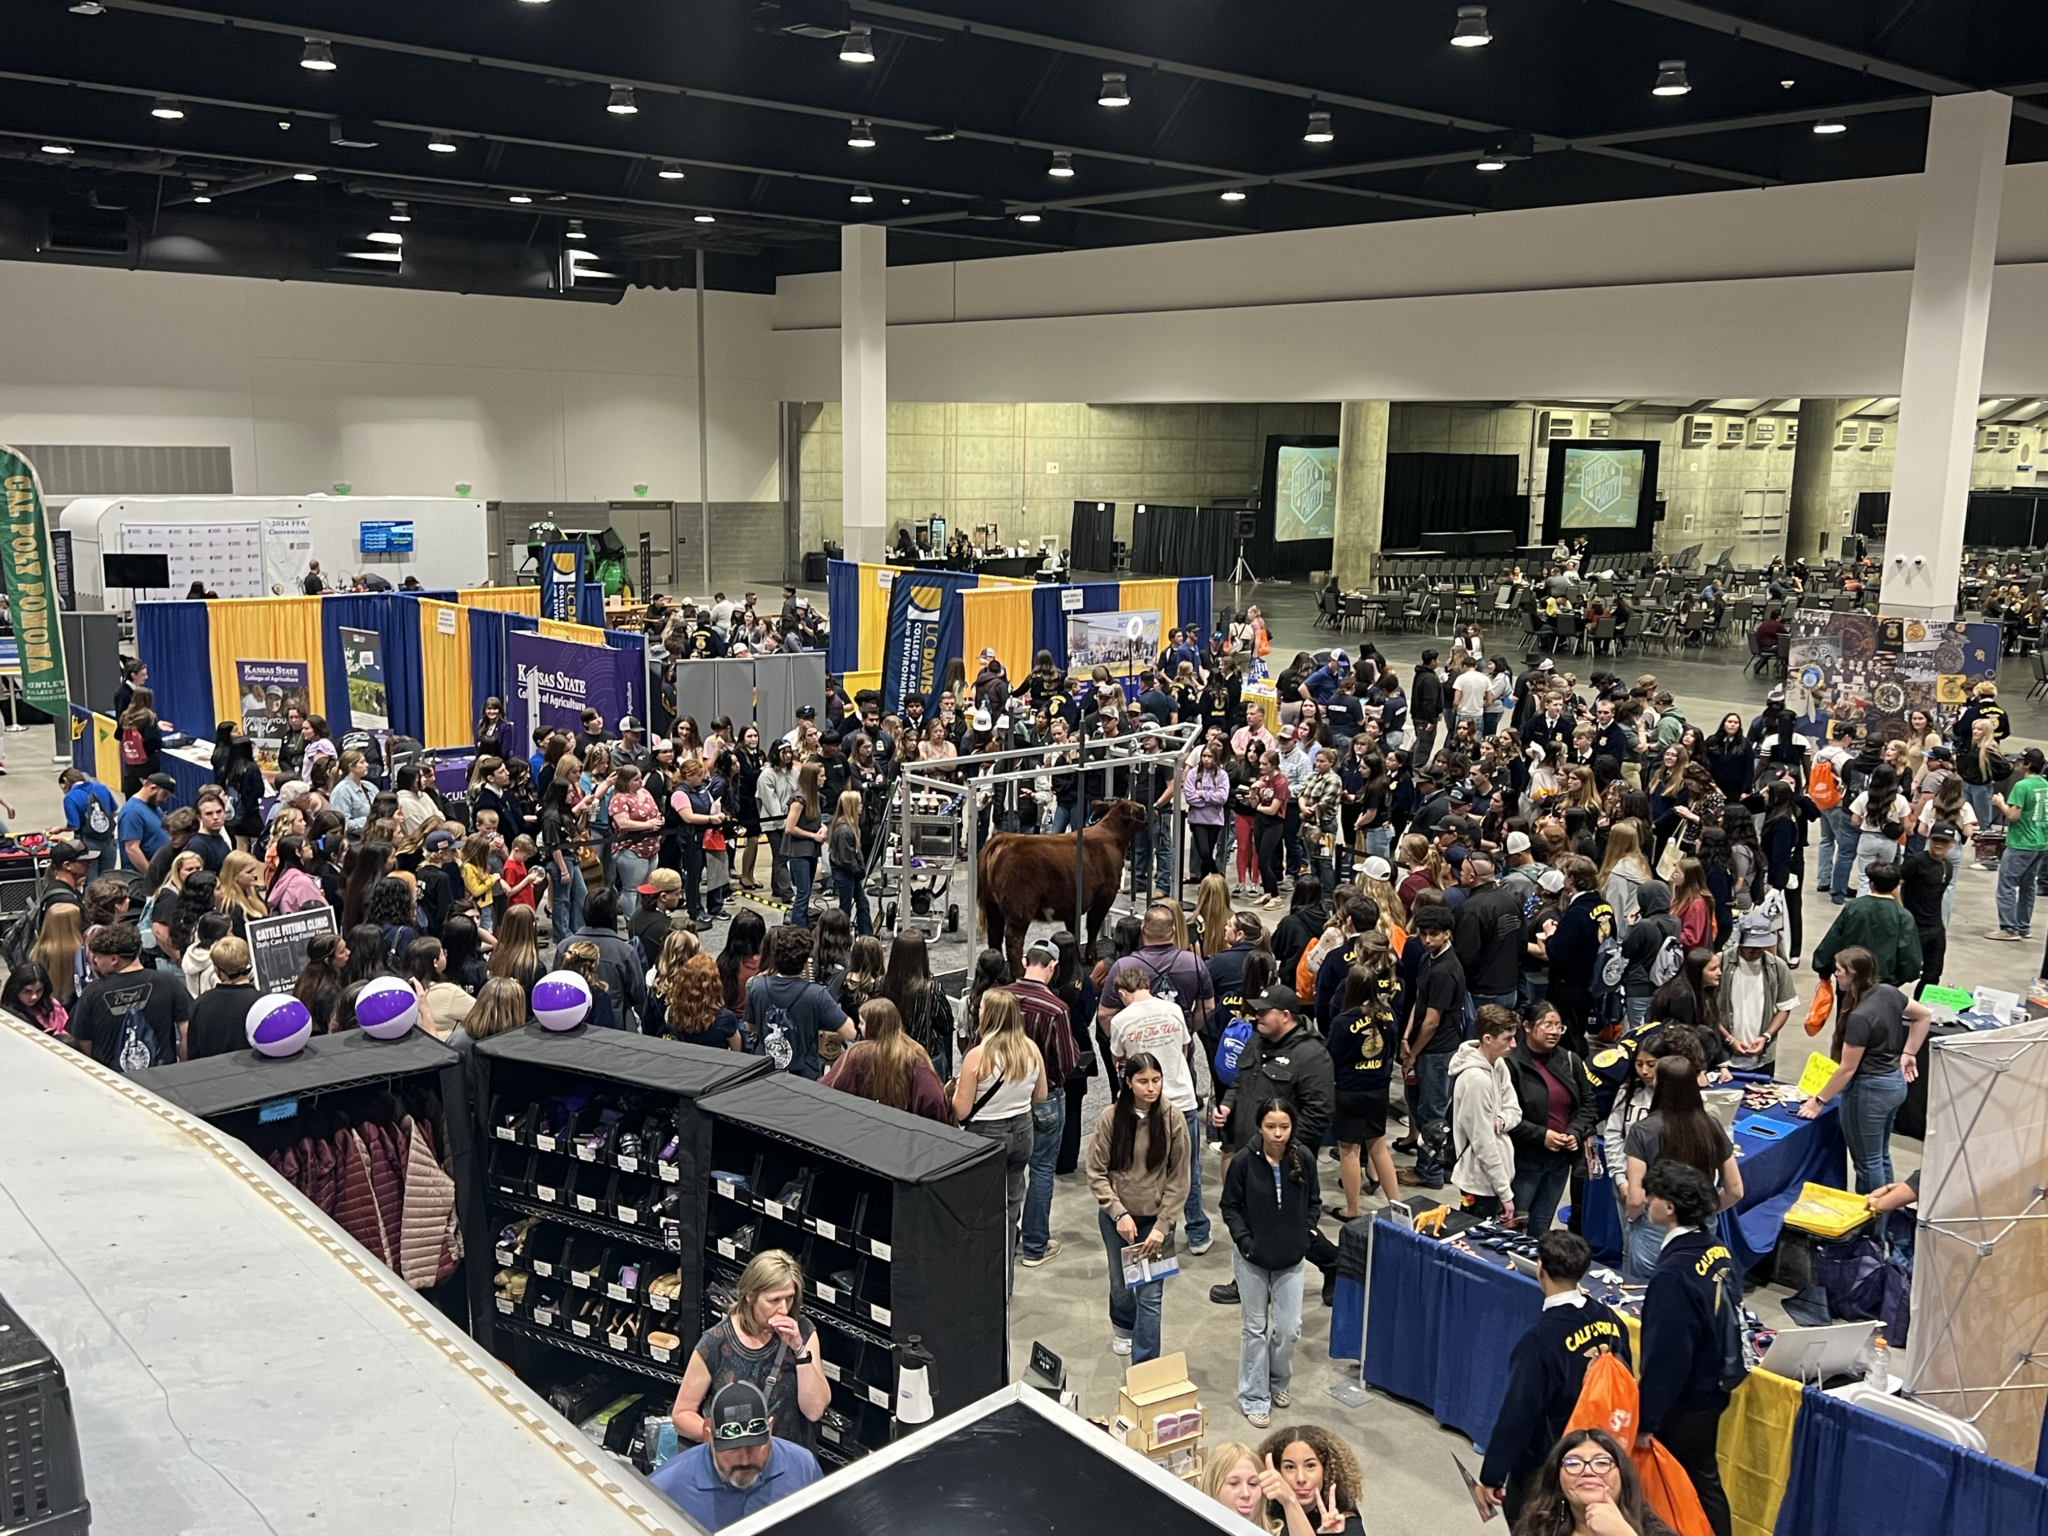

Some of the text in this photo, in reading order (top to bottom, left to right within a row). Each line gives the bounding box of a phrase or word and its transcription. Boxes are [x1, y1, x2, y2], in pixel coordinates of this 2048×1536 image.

[4, 475, 54, 674] CAL POLY POMONA
[911, 622, 922, 662] COLLEGE
[244, 665, 299, 677] KANSAS STATE
[556, 671, 587, 695] STATE
[541, 693, 549, 704] of
[549, 693, 587, 712] Agriculture
[255, 915, 329, 942] CATTLE FITTING CLINIC
[256, 941, 270, 949] Daily
[270, 938, 282, 946] Care
[1126, 1030, 1143, 1043] Off
[1143, 1025, 1160, 1039] The
[1565, 1321, 1620, 1352] CALIFORNIA
